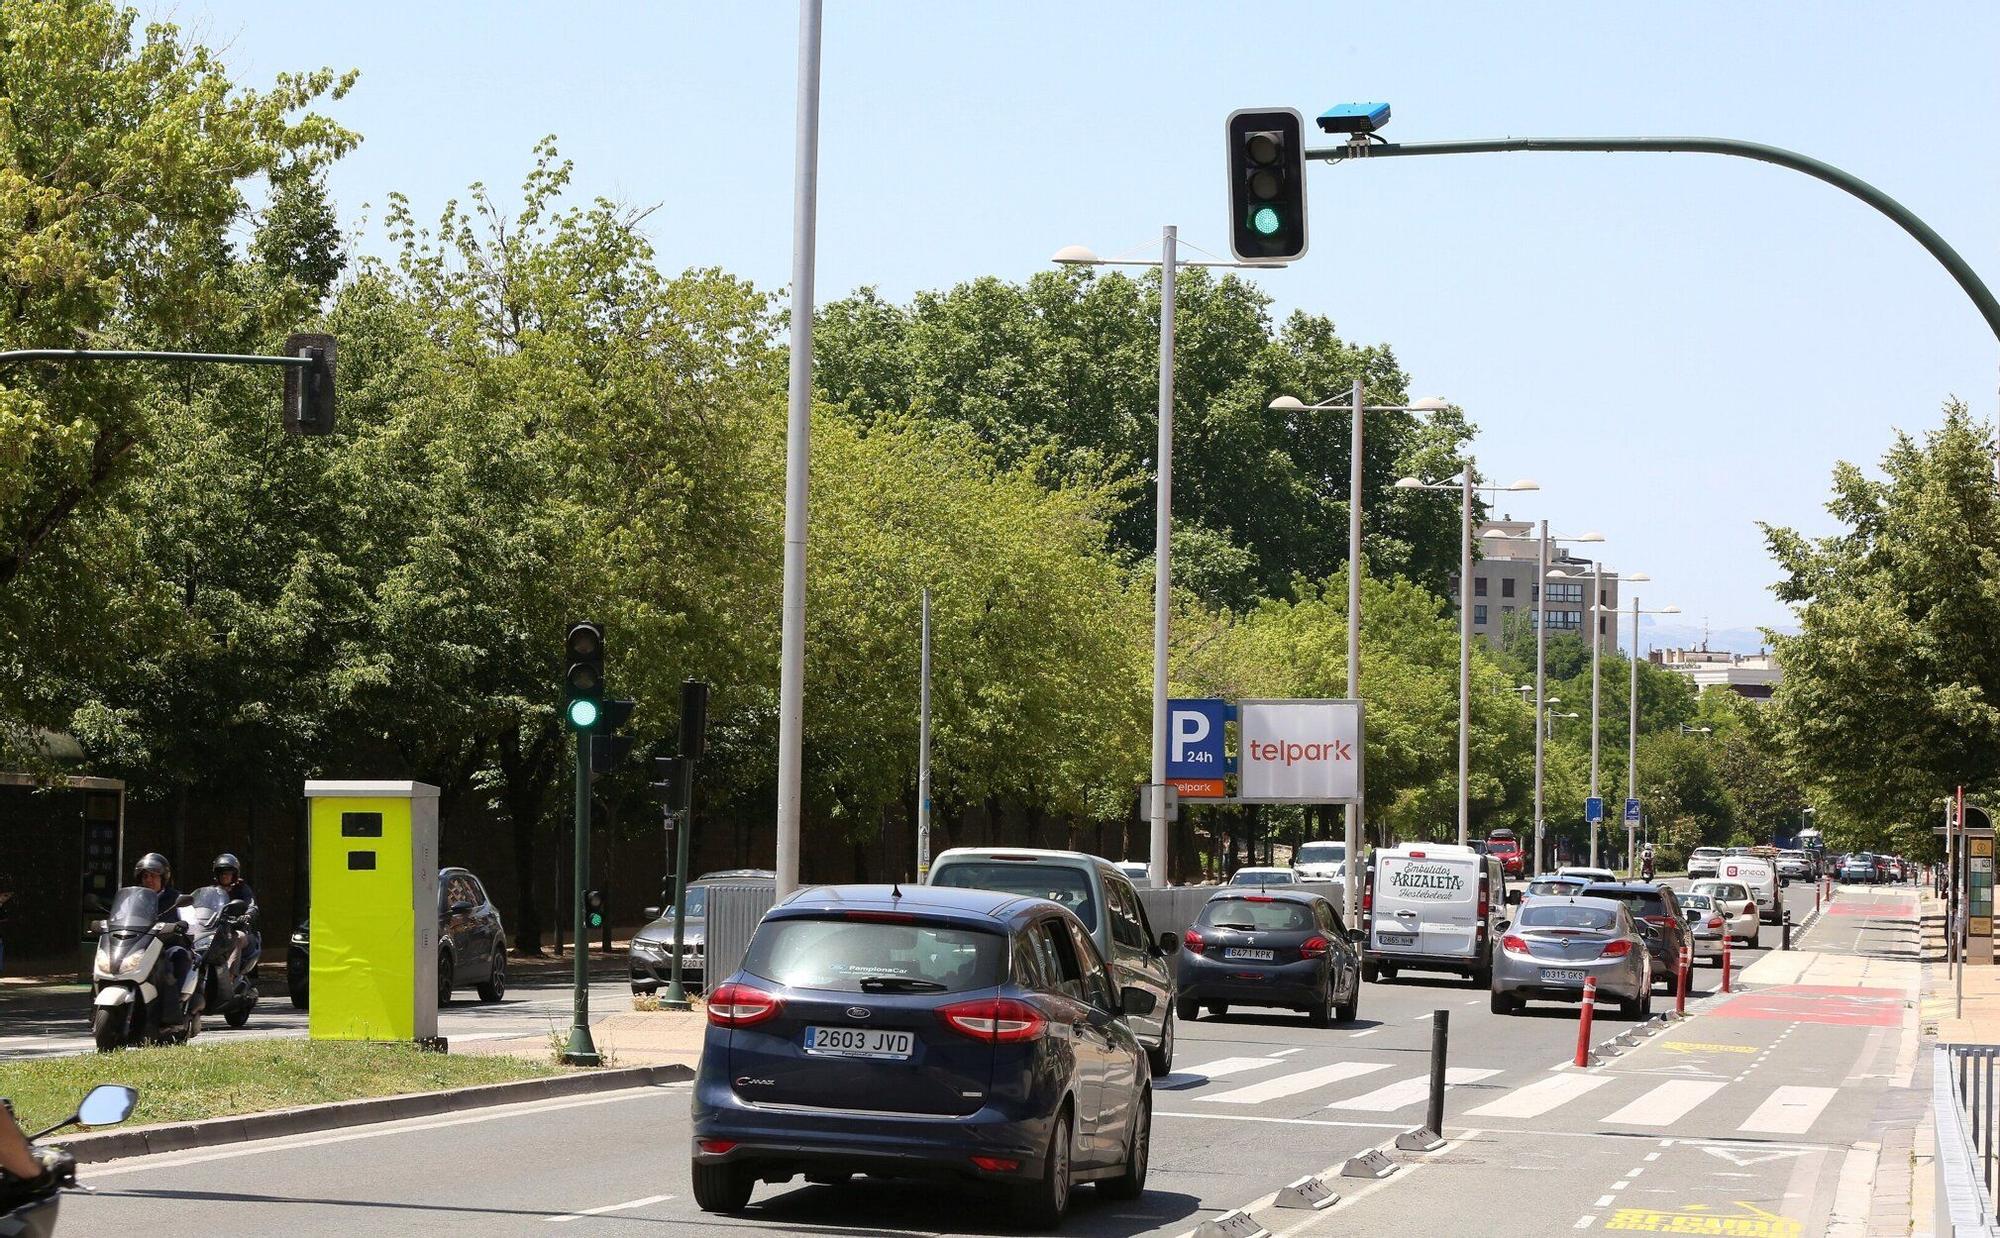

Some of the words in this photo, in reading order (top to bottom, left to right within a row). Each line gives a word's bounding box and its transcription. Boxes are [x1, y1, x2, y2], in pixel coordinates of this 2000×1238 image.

[1172, 710, 1210, 762] P
[1187, 751, 1213, 763] 24h
[1250, 739, 1352, 767] telpark
[1175, 782, 1212, 792] elpark
[1740, 869, 1766, 877] oneca
[1231, 948, 1252, 957] 6471
[1255, 950, 1271, 959] KPK
[849, 965, 908, 974] PamplonaCar
[1545, 970, 1566, 979] 0315
[1568, 971, 1584, 980] GKS
[817, 1029, 866, 1049] 2603
[872, 1033, 908, 1053] JVD
